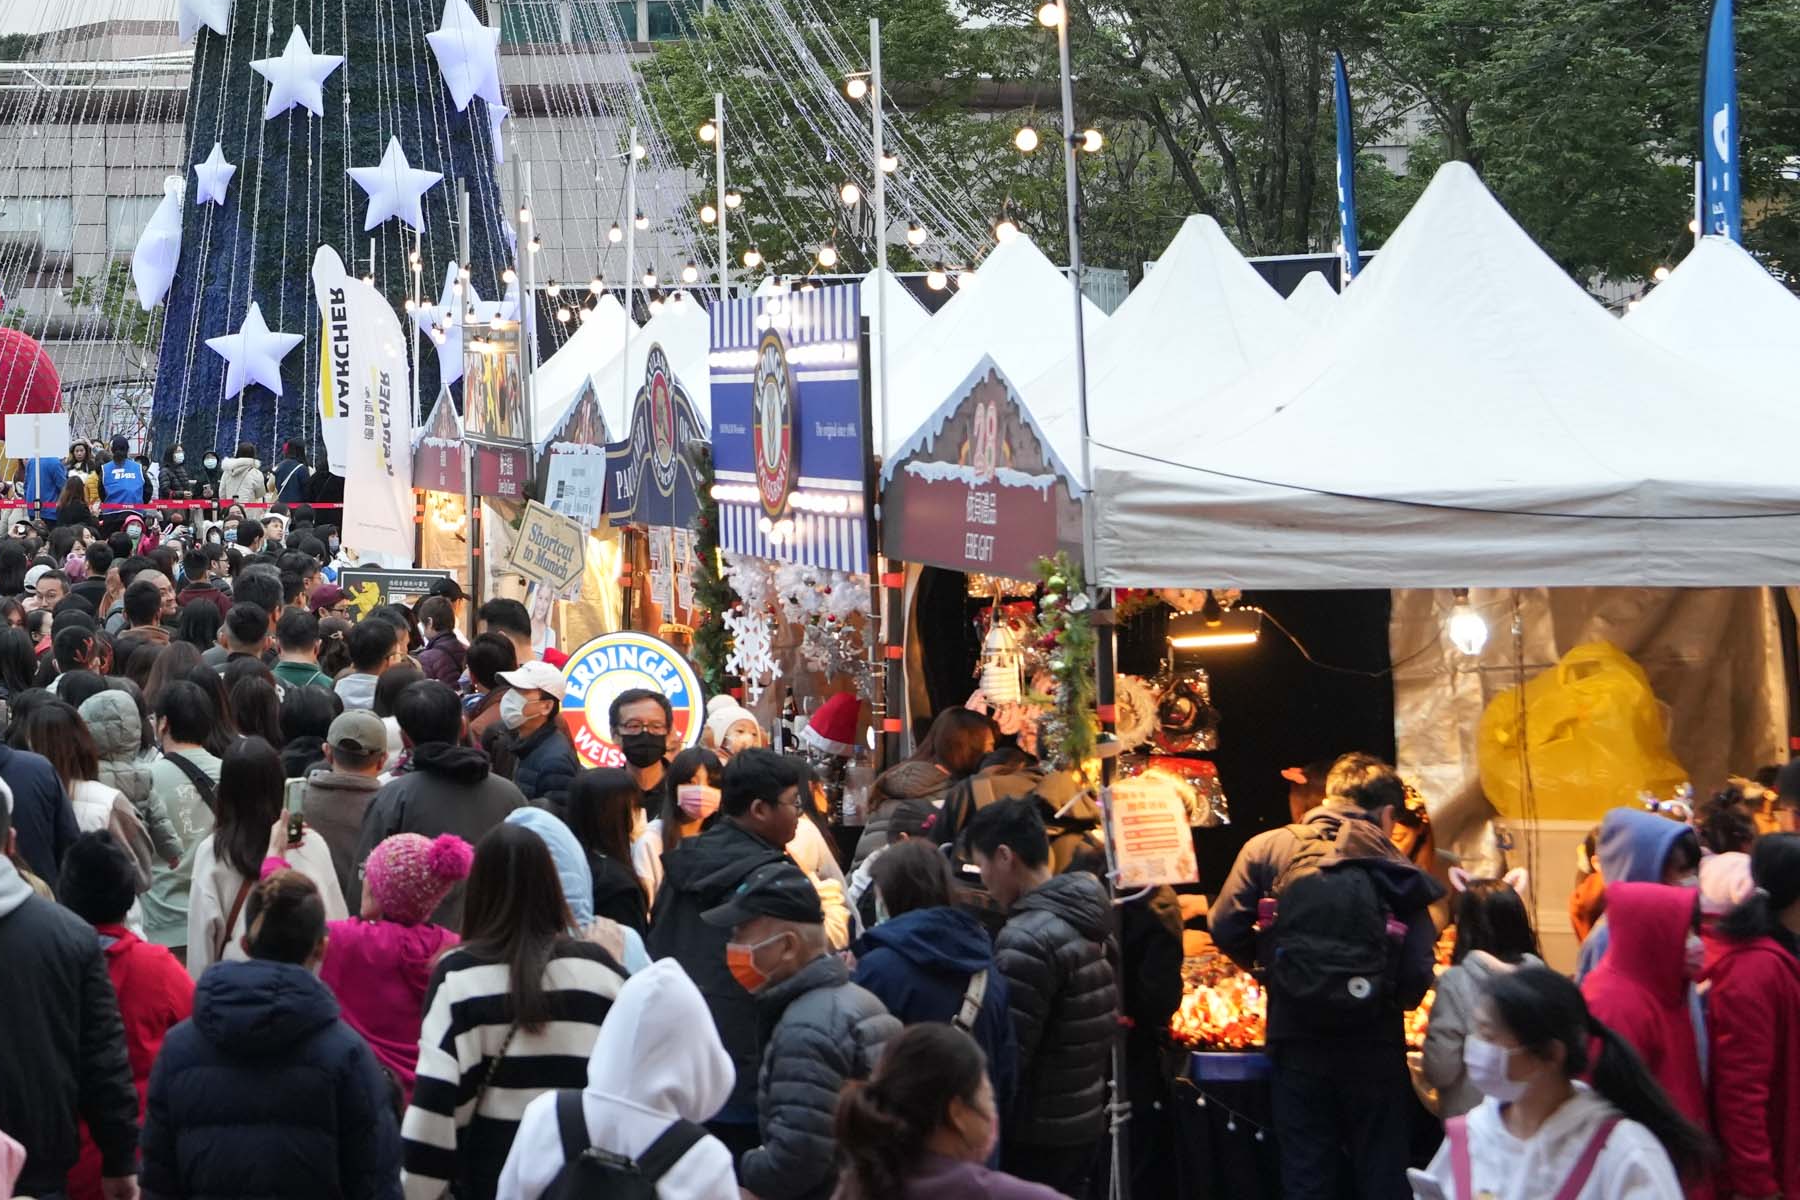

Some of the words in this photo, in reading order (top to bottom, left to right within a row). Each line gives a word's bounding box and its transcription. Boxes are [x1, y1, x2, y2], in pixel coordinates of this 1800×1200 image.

[523, 544, 534, 562] to
[534, 547, 568, 580] Munich
[528, 522, 575, 563] Shortcut
[565, 644, 684, 701] ERDINGER
